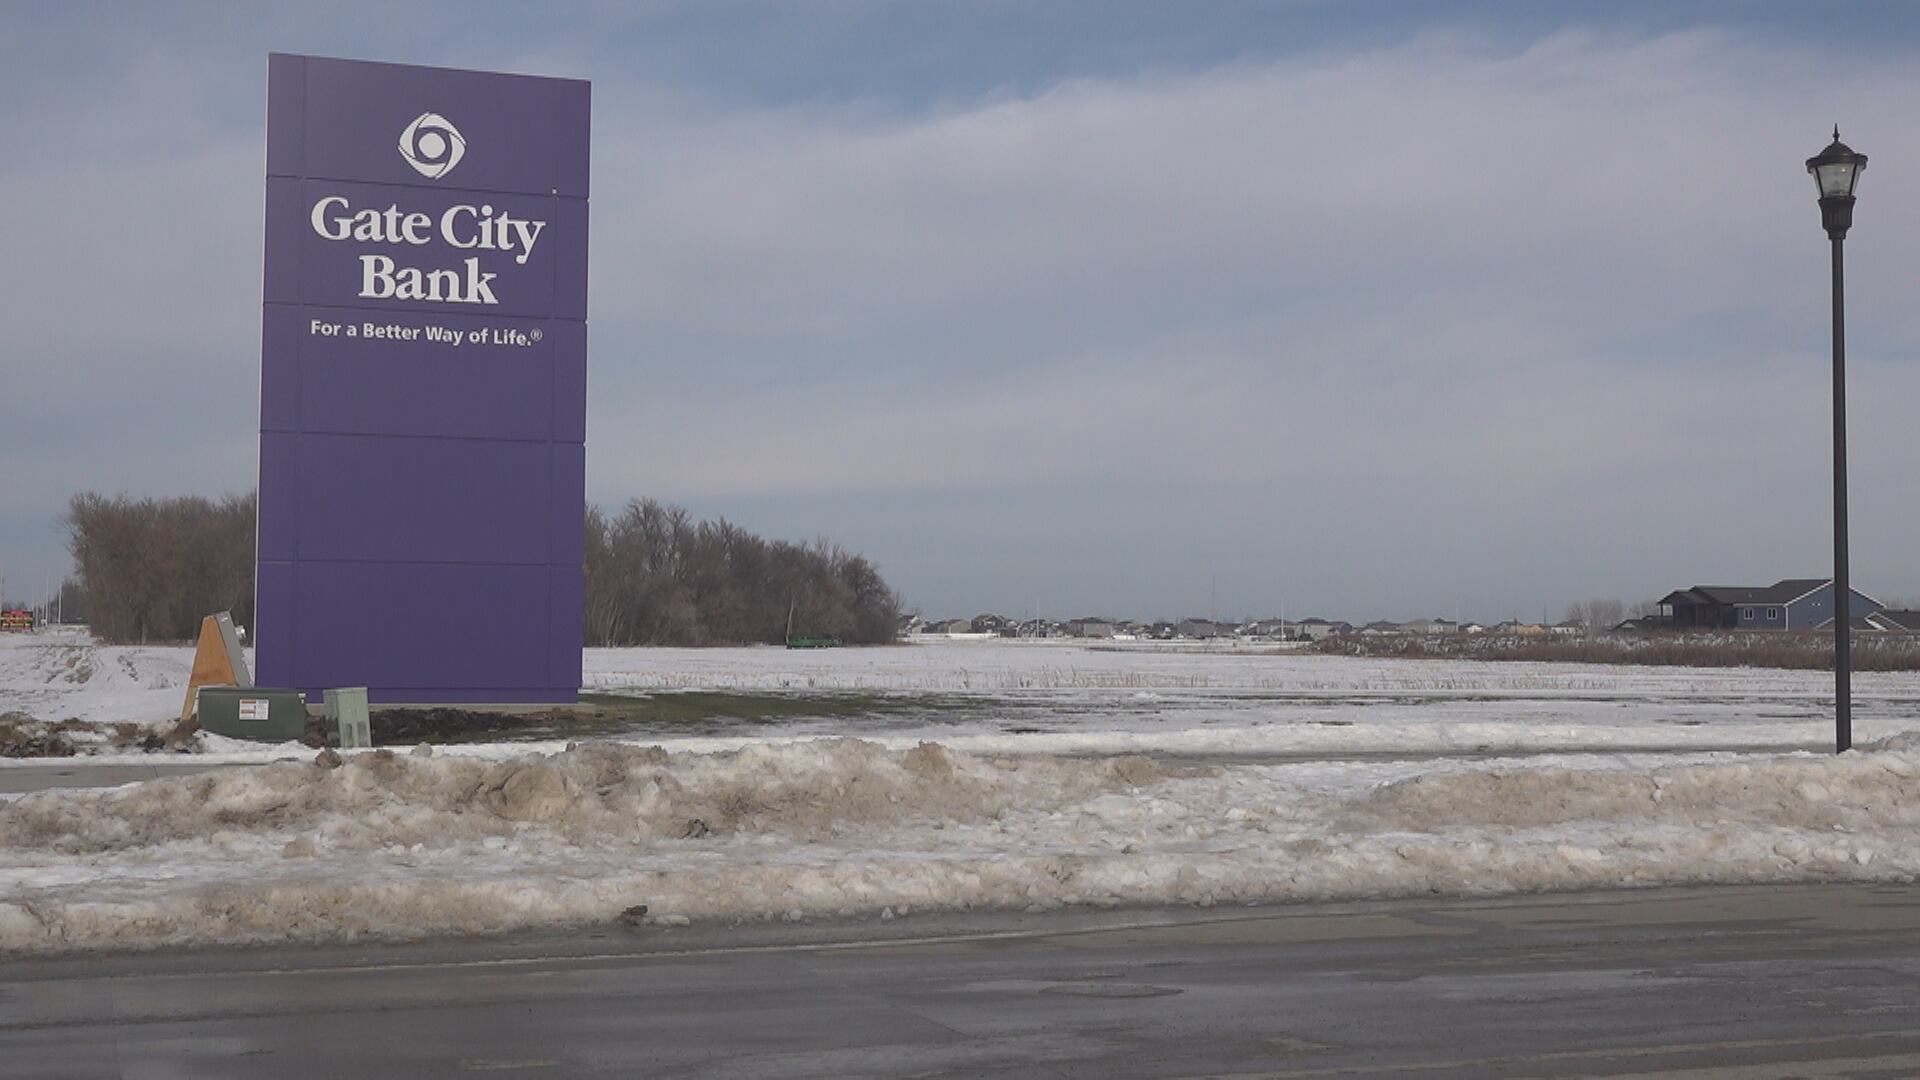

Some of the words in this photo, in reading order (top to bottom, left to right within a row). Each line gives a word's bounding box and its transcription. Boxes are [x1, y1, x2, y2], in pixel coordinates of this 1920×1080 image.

[310, 196, 432, 245] Gate
[440, 204, 547, 265] City
[357, 254, 499, 305] Bank
[310, 319, 342, 336] For
[346, 325, 357, 337] a
[363, 322, 421, 340] Better
[425, 325, 464, 347] Way
[468, 327, 489, 344] of
